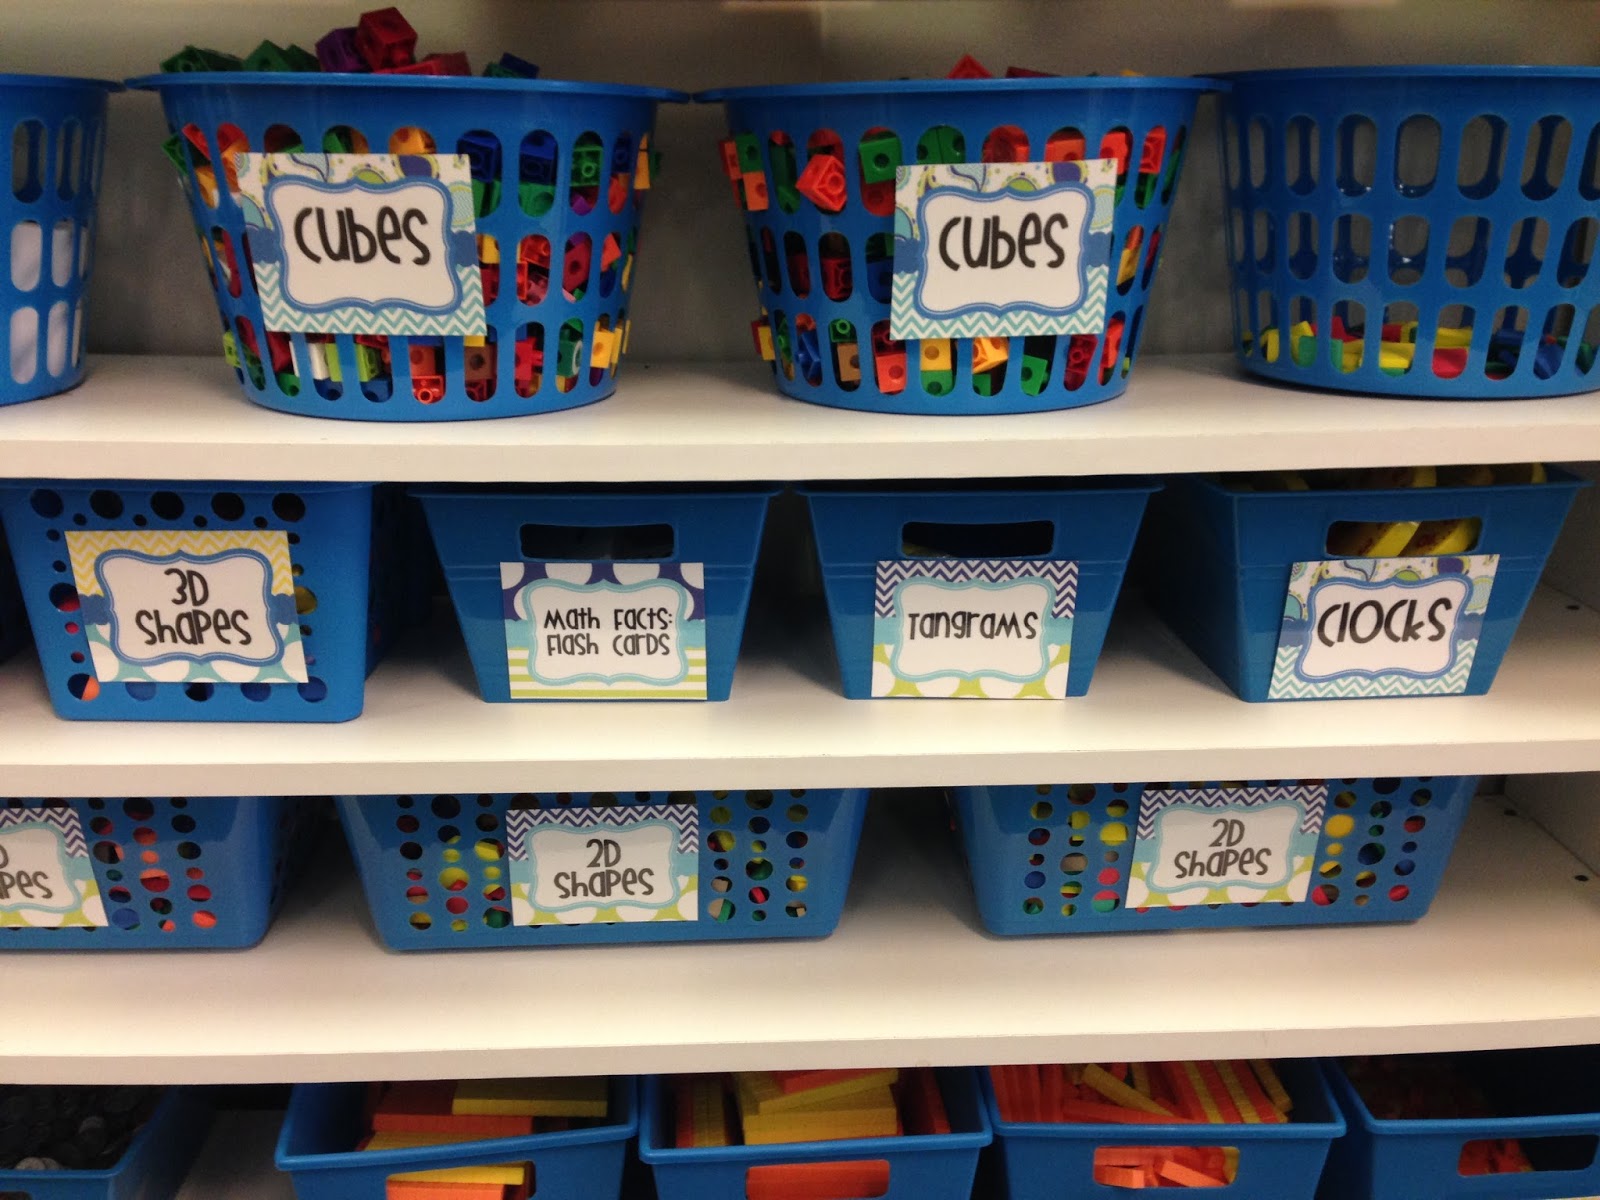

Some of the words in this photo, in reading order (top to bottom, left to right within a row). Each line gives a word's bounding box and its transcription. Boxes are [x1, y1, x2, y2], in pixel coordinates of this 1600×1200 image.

[164, 568, 209, 606] 3D
[543, 607, 600, 630] Math
[613, 607, 673, 630] Facts:
[546, 633, 599, 657] Flash
[1208, 818, 1245, 847] 2D
[586, 838, 621, 868] 2D
